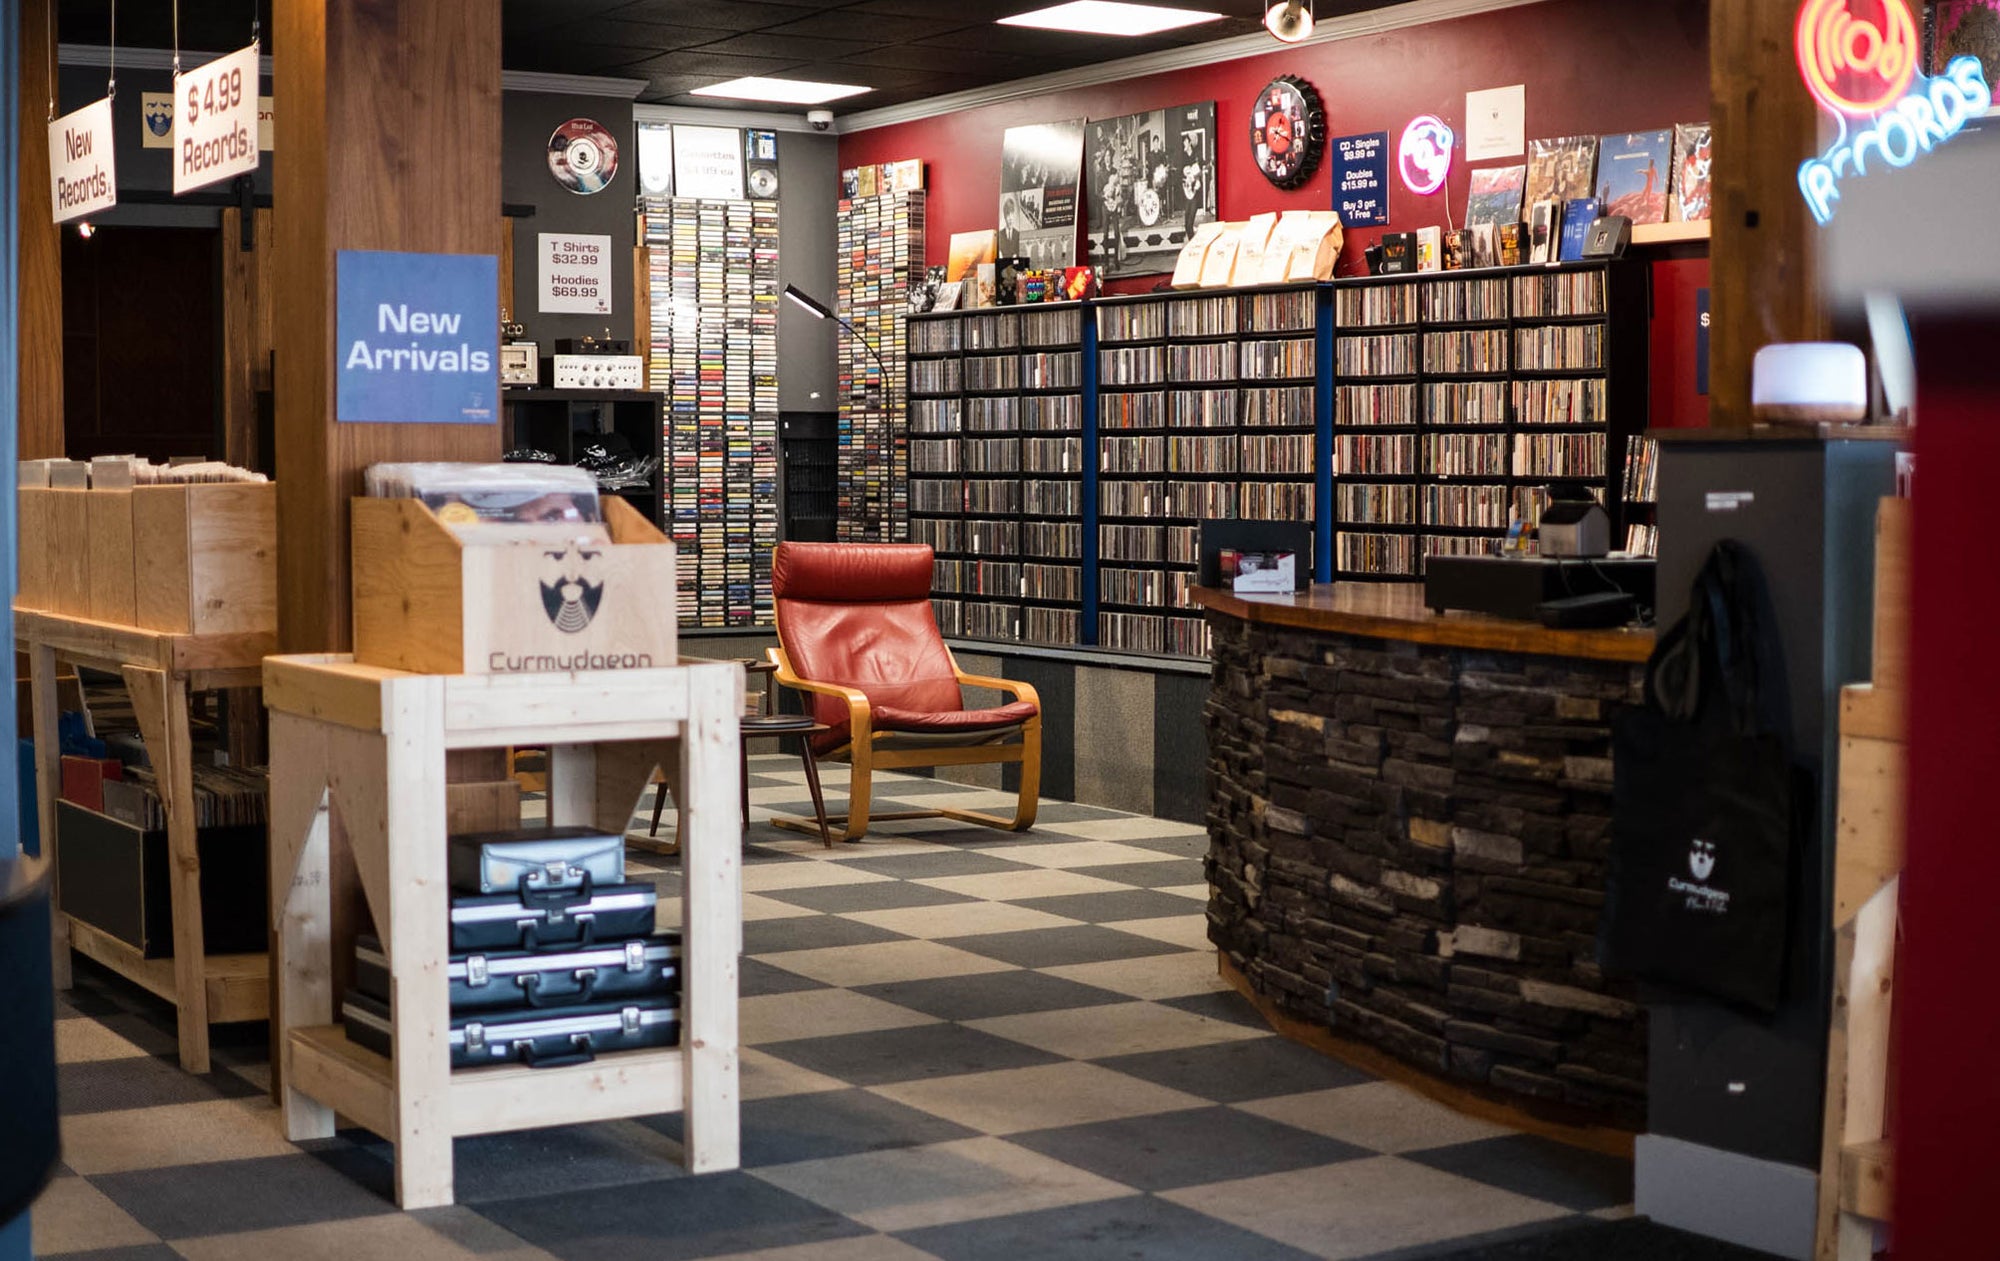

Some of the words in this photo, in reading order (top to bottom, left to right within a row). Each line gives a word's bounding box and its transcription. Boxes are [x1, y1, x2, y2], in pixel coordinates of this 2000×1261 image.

[65, 128, 92, 163] New
[183, 120, 248, 176] Records
[1355, 139, 1379, 149] Singles
[1346, 170, 1372, 180] Doubles
[58, 164, 107, 210] Records
[1341, 179, 1367, 191] $15.99
[1343, 201, 1356, 212] Buy
[1357, 200, 1363, 209] 3
[1364, 199, 1376, 210] get
[1355, 210, 1371, 219] Free
[550, 241, 559, 252] T
[563, 242, 600, 253] Shirts
[552, 253, 598, 265] $32.99
[551, 274, 599, 285] Hoodies
[552, 286, 598, 298] $69.99
[378, 303, 461, 335] New
[346, 340, 491, 373] Arrivals
